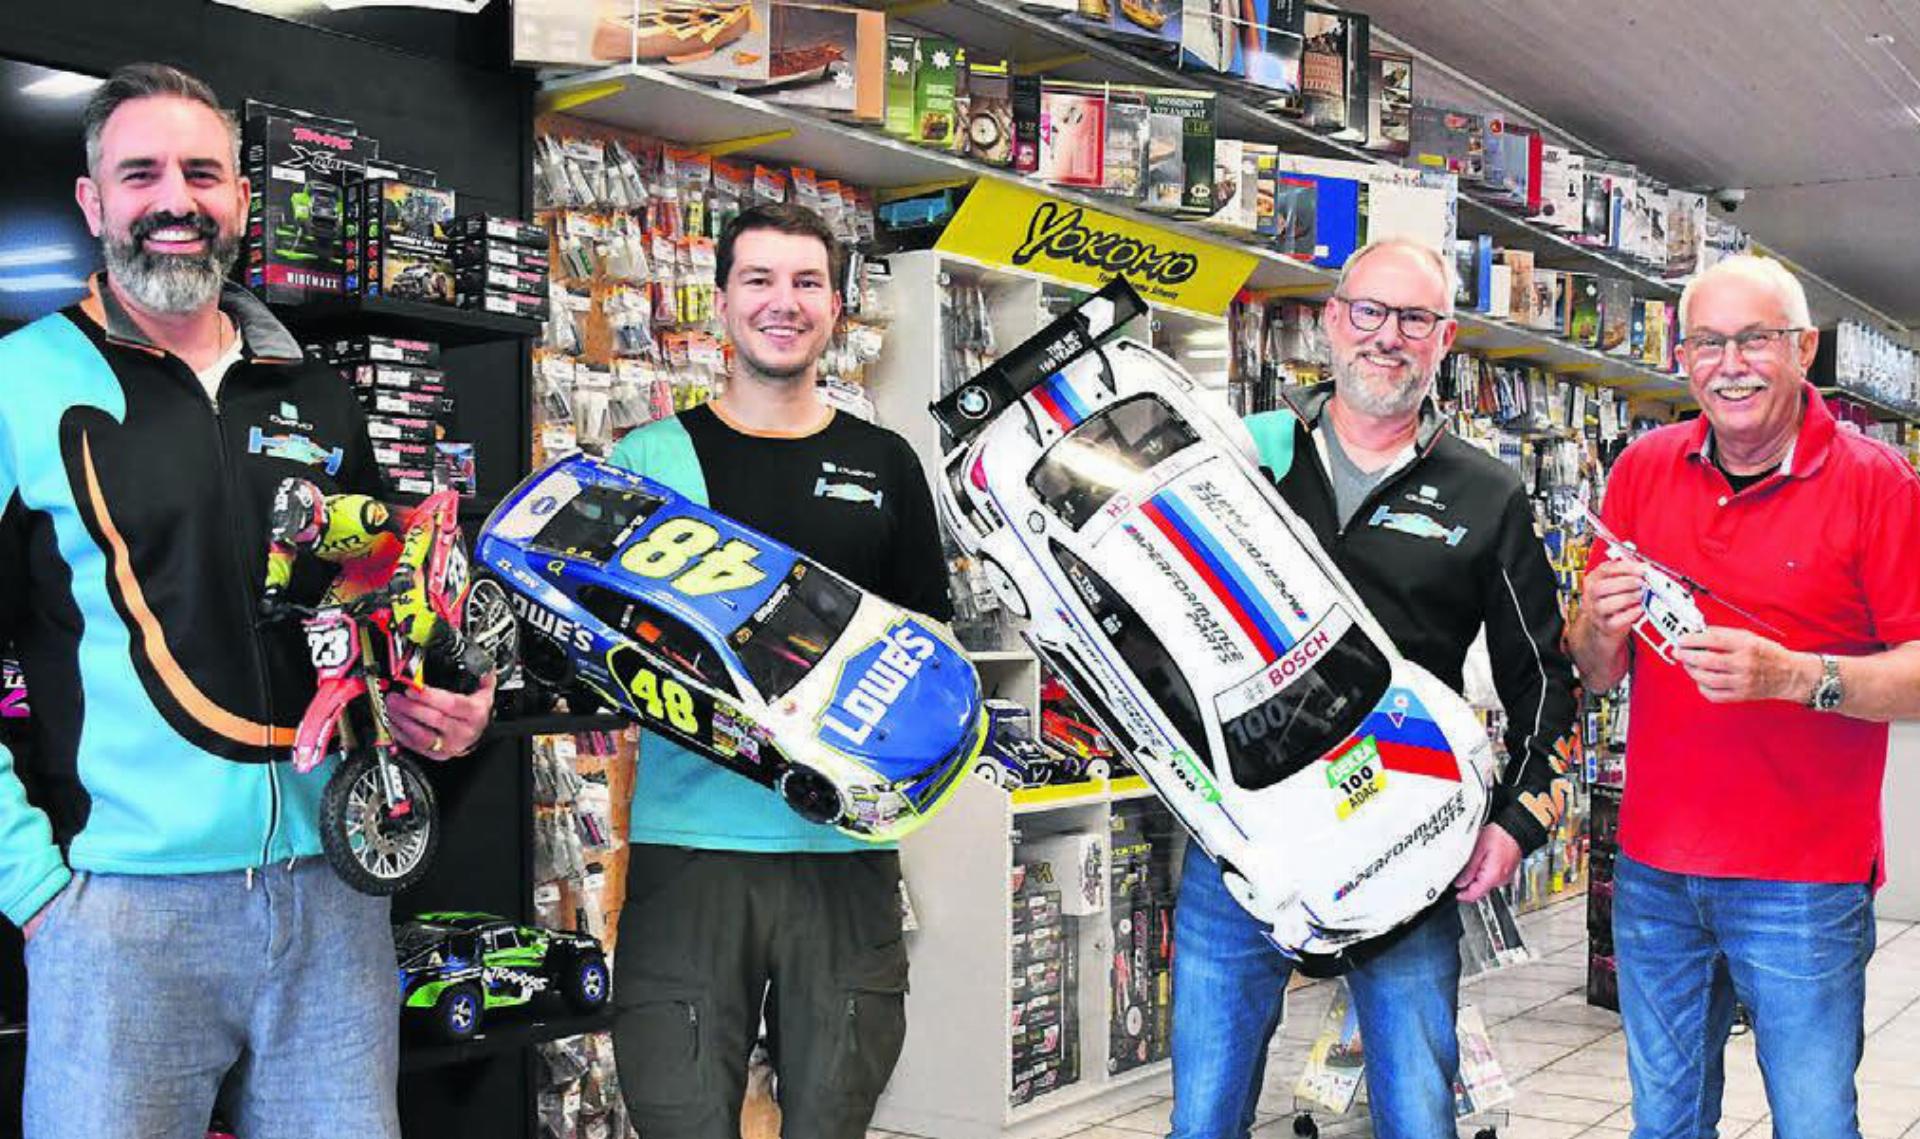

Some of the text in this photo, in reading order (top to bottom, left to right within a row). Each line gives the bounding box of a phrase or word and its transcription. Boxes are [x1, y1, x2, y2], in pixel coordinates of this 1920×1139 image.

[1012, 202, 1198, 283] YOKOMO
[619, 516, 771, 598] 48
[820, 627, 936, 746] LOWE'S
[1268, 630, 1330, 688] BOSCH
[630, 667, 699, 735] 48
[1226, 700, 1289, 748] 100
[1339, 765, 1374, 797] 100
[1348, 781, 1379, 809] ADAC
